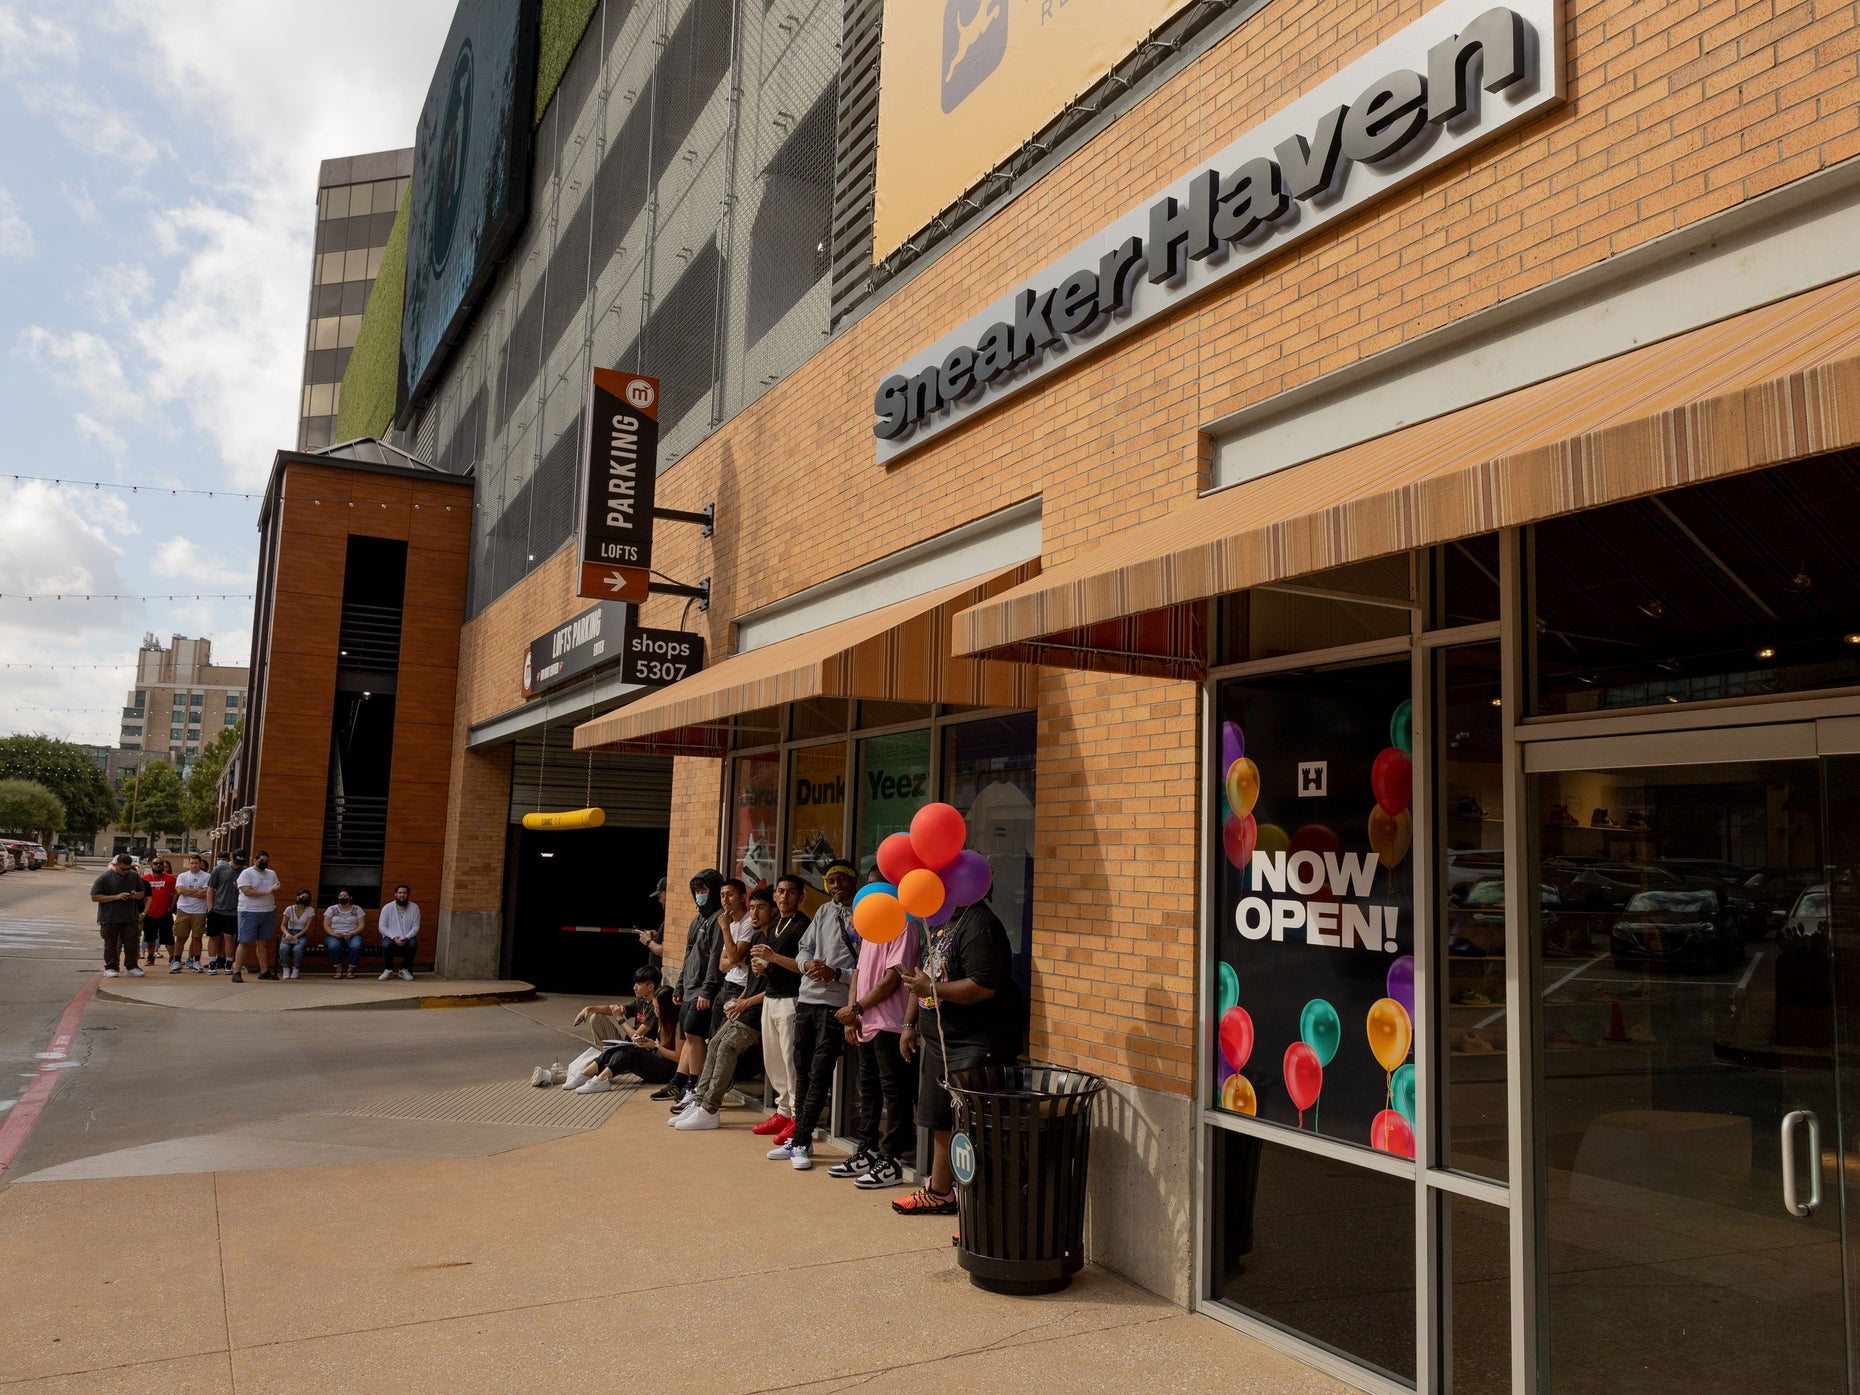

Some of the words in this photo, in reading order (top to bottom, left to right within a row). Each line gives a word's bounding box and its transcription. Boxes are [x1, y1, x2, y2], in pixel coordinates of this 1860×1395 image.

[606, 414, 639, 529] PARKING
[601, 543, 638, 561] LOFTS
[552, 625, 572, 659] LOFTS
[571, 608, 602, 649] PARKING
[632, 634, 690, 659] shops
[636, 660, 687, 680] 5307
[867, 769, 930, 800] Yeez
[1251, 850, 1380, 897] NOW
[1235, 896, 1399, 953] OPEN!
